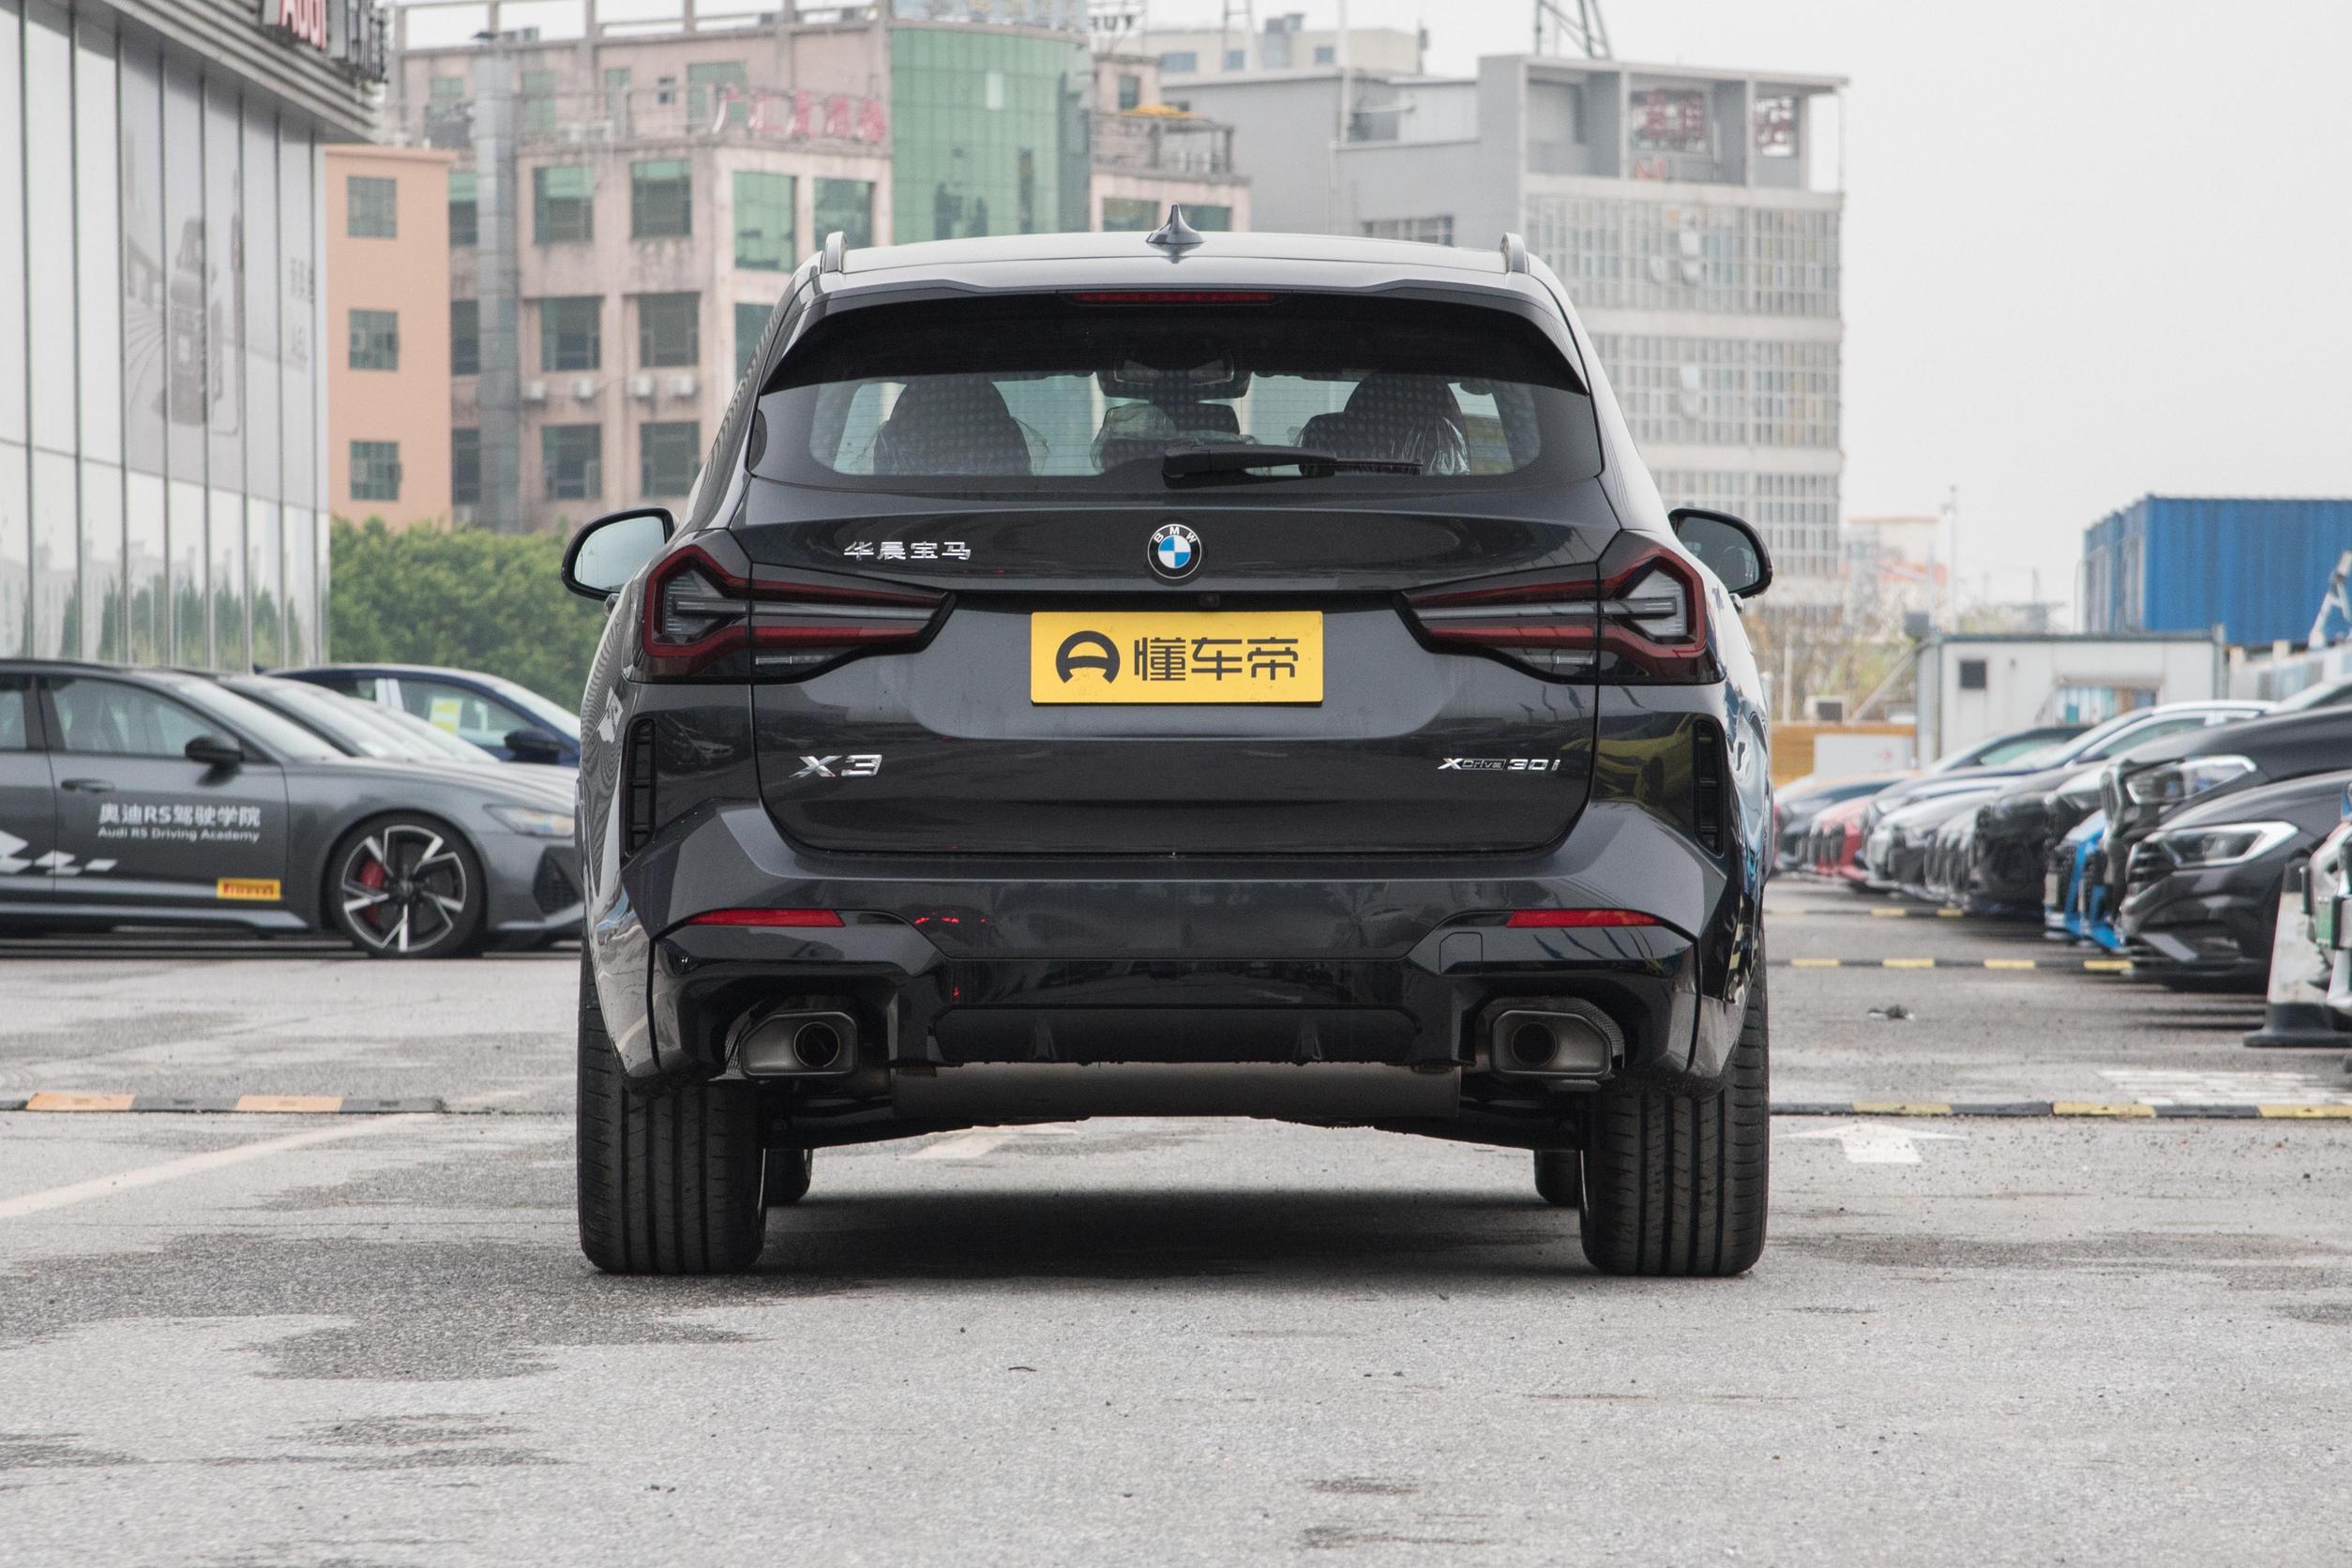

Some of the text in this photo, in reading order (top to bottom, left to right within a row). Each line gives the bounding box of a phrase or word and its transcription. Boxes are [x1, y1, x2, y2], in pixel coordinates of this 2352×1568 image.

[1153, 526, 1197, 544] BMW
[844, 541, 972, 561] 华晨宝马
[1134, 637, 1299, 681] 懂车帝
[788, 754, 882, 778] X3
[98, 803, 261, 827] 奥迪RS驾驶学院
[98, 826, 128, 838] Audi
[151, 827, 197, 842] Driving
[200, 829, 261, 844] Academy
